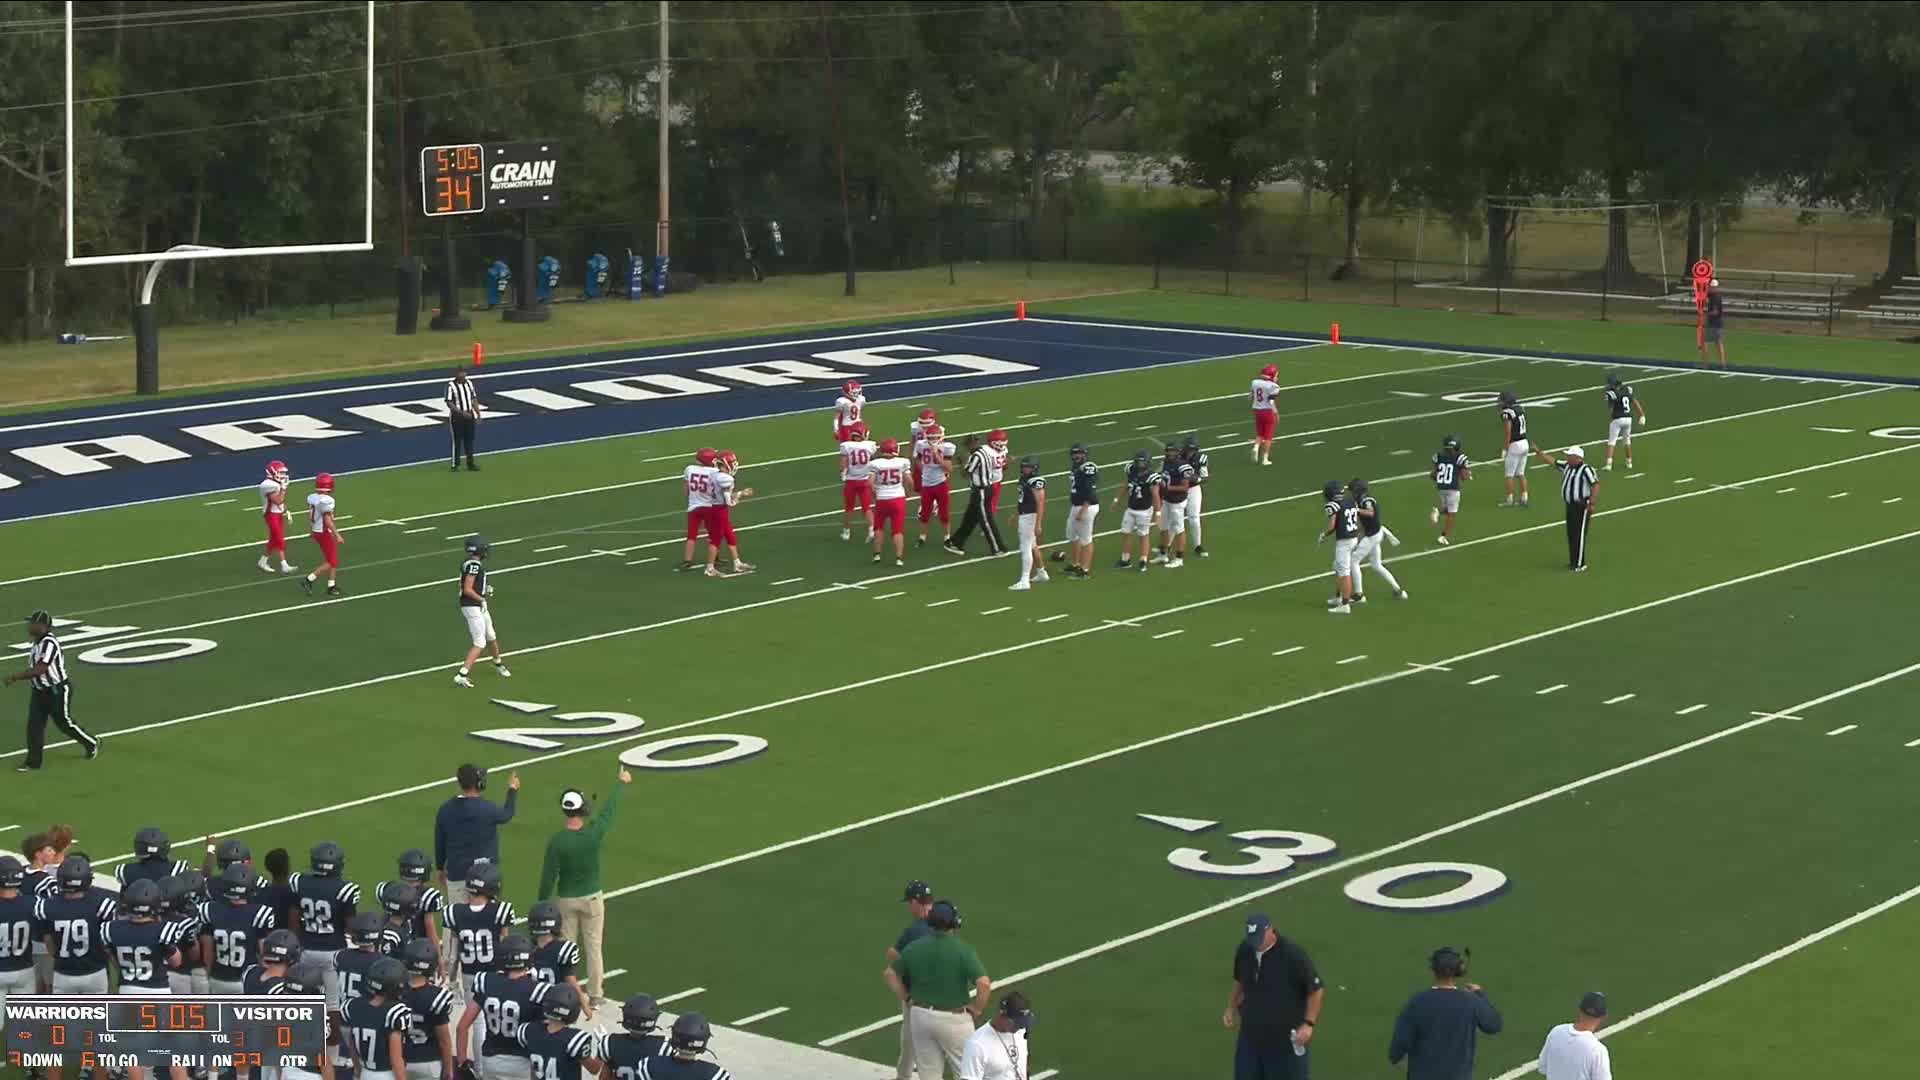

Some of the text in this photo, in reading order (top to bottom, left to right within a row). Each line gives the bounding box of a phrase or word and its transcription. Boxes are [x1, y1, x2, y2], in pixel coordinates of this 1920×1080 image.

[490, 160, 556, 182] CRAIN
[491, 178, 553, 190] AUTOMOTIVE TEAM
[436, 175, 472, 211] 34
[0, 345, 1040, 490] ARRIORS
[850, 405, 858, 420] 9
[851, 449, 868, 465] 10
[1437, 463, 1453, 484] 20
[690, 473, 708, 492] 55
[880, 469, 900, 485] 75
[469, 564, 480, 574] 12
[467, 711, 769, 768] 20
[1167, 829, 1508, 911] 30
[301, 897, 335, 934] 22
[54, 919, 89, 957] 79
[213, 930, 247, 968] 26
[460, 929, 494, 964] 30
[116, 946, 153, 981] 56
[484, 996, 520, 1038] 88
[352, 1027, 377, 1069] 17
